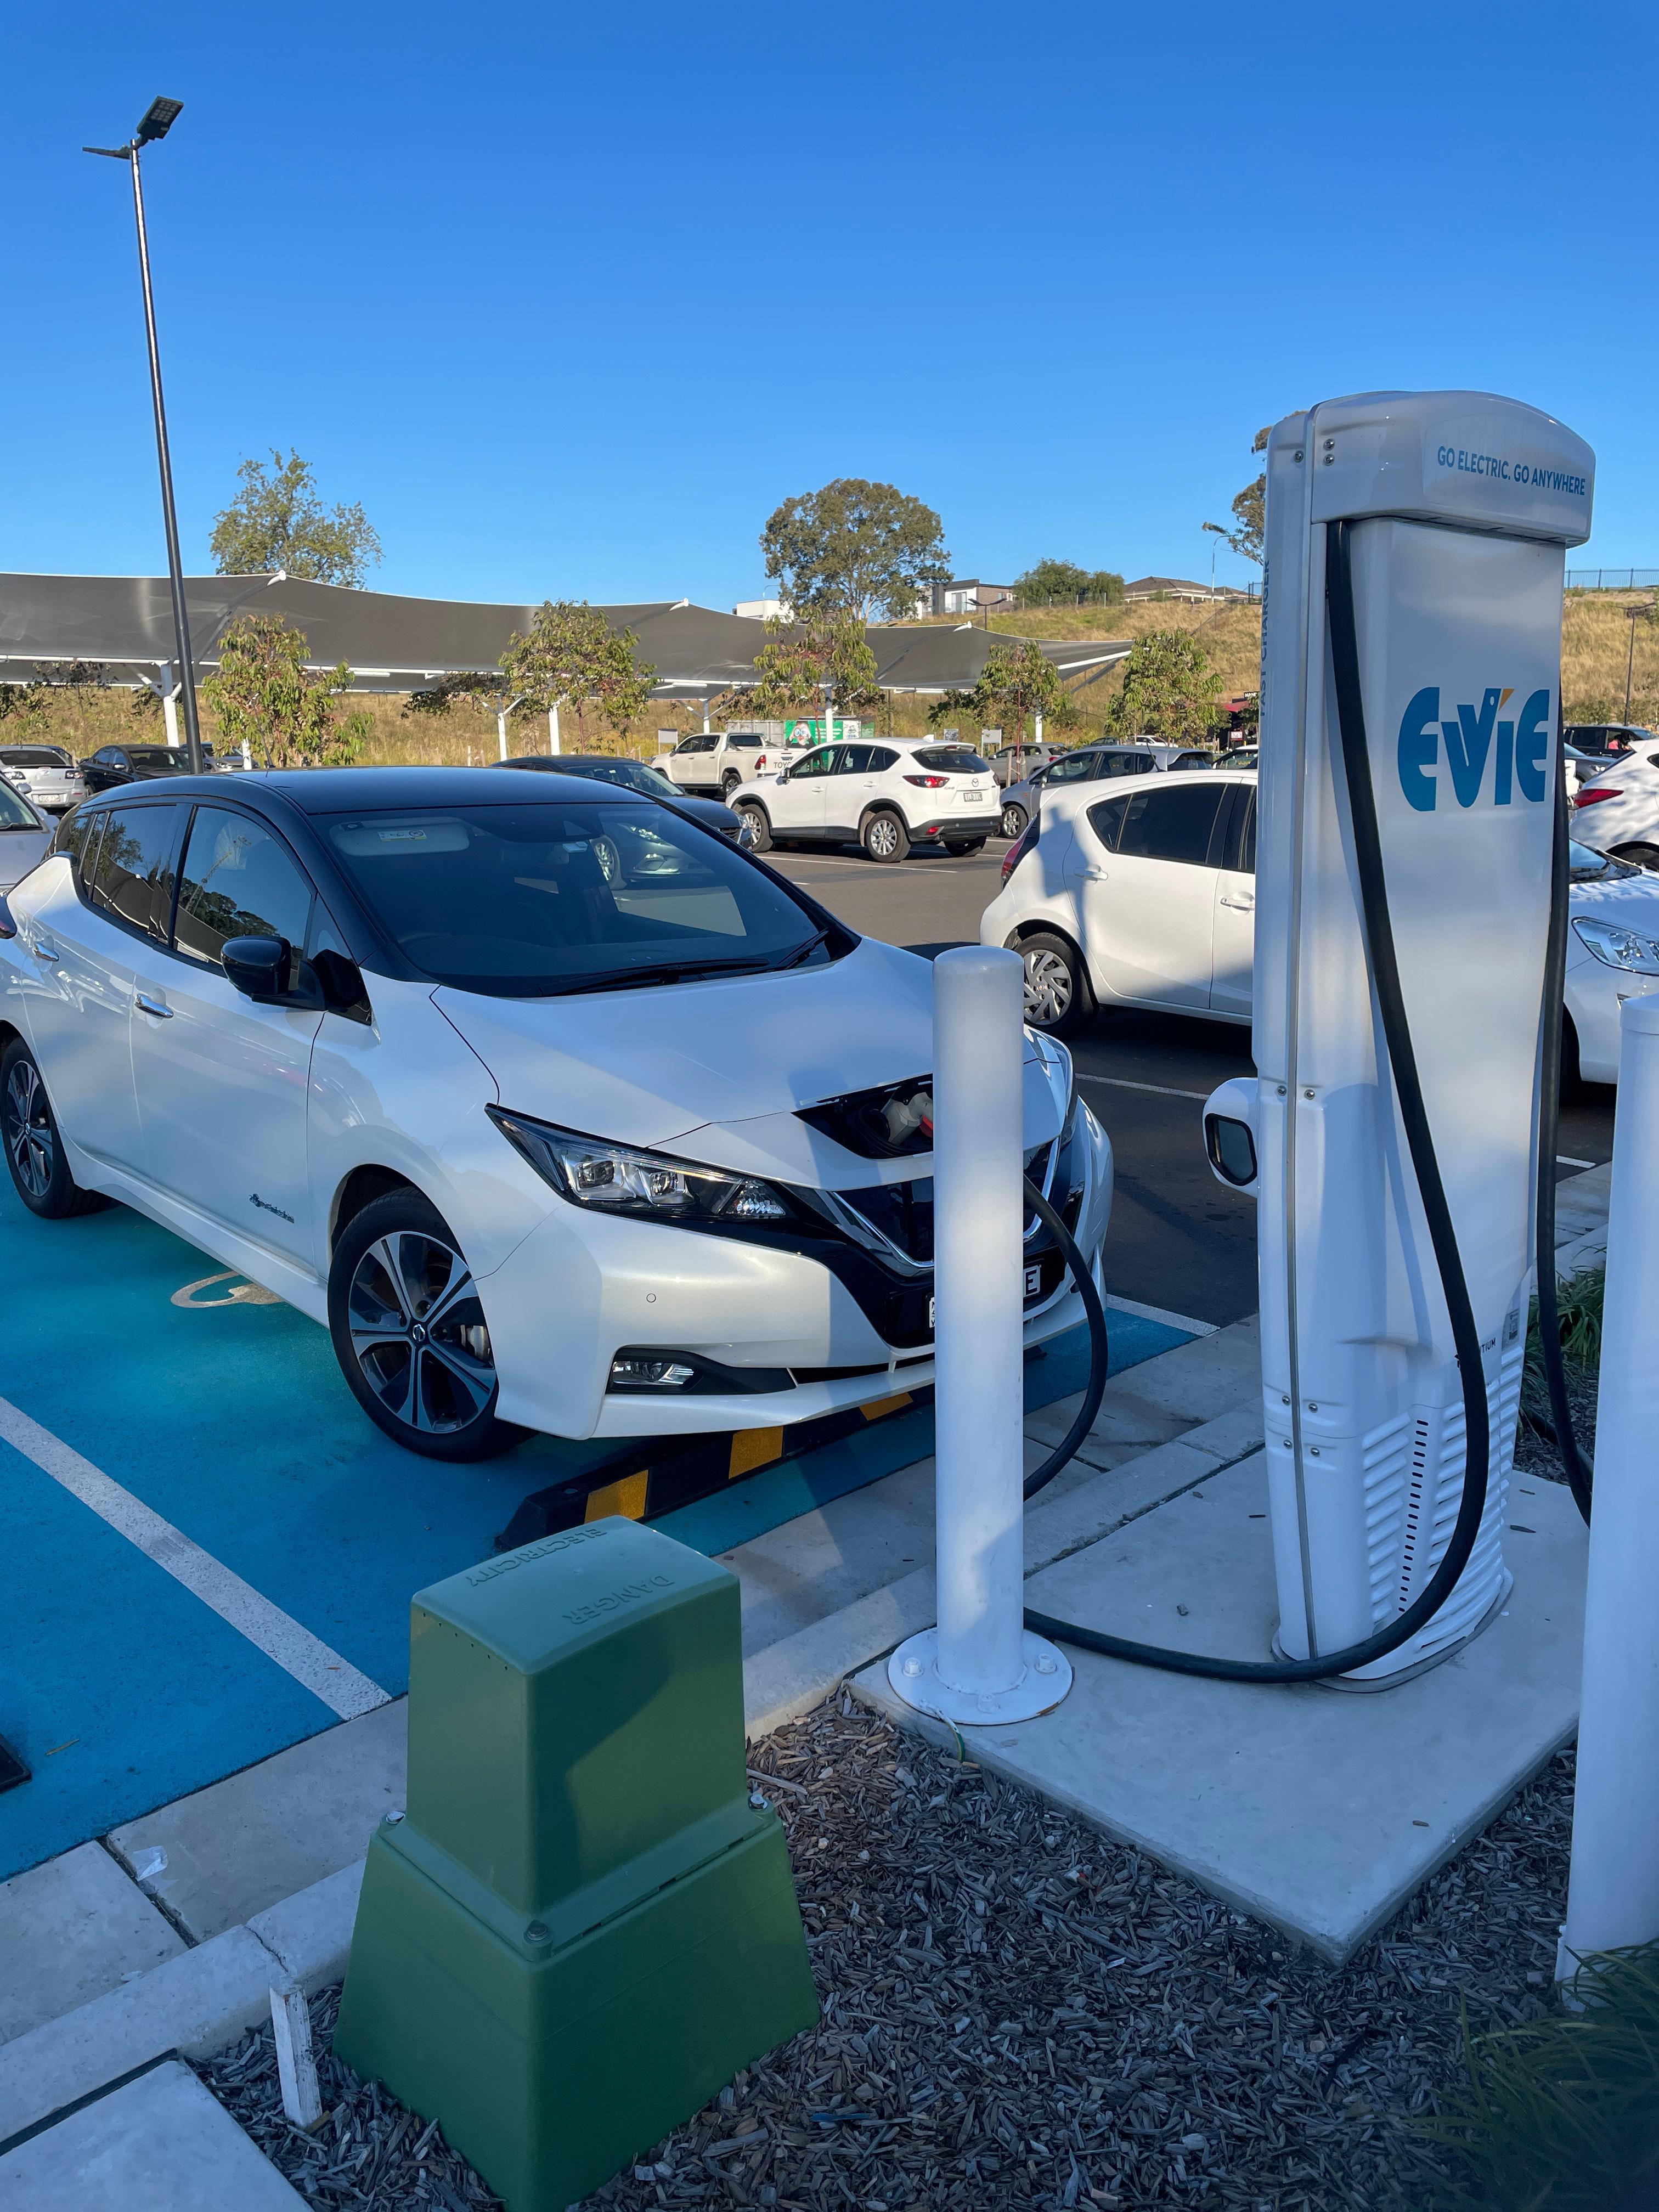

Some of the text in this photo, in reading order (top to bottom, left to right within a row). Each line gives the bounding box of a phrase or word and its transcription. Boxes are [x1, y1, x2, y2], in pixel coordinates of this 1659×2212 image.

[1437, 445, 1585, 495] GO ELECTRIC. GO ANYWHERE
[466, 1528, 607, 1587] ELECTRICITY
[562, 1576, 675, 1624] DANGER
